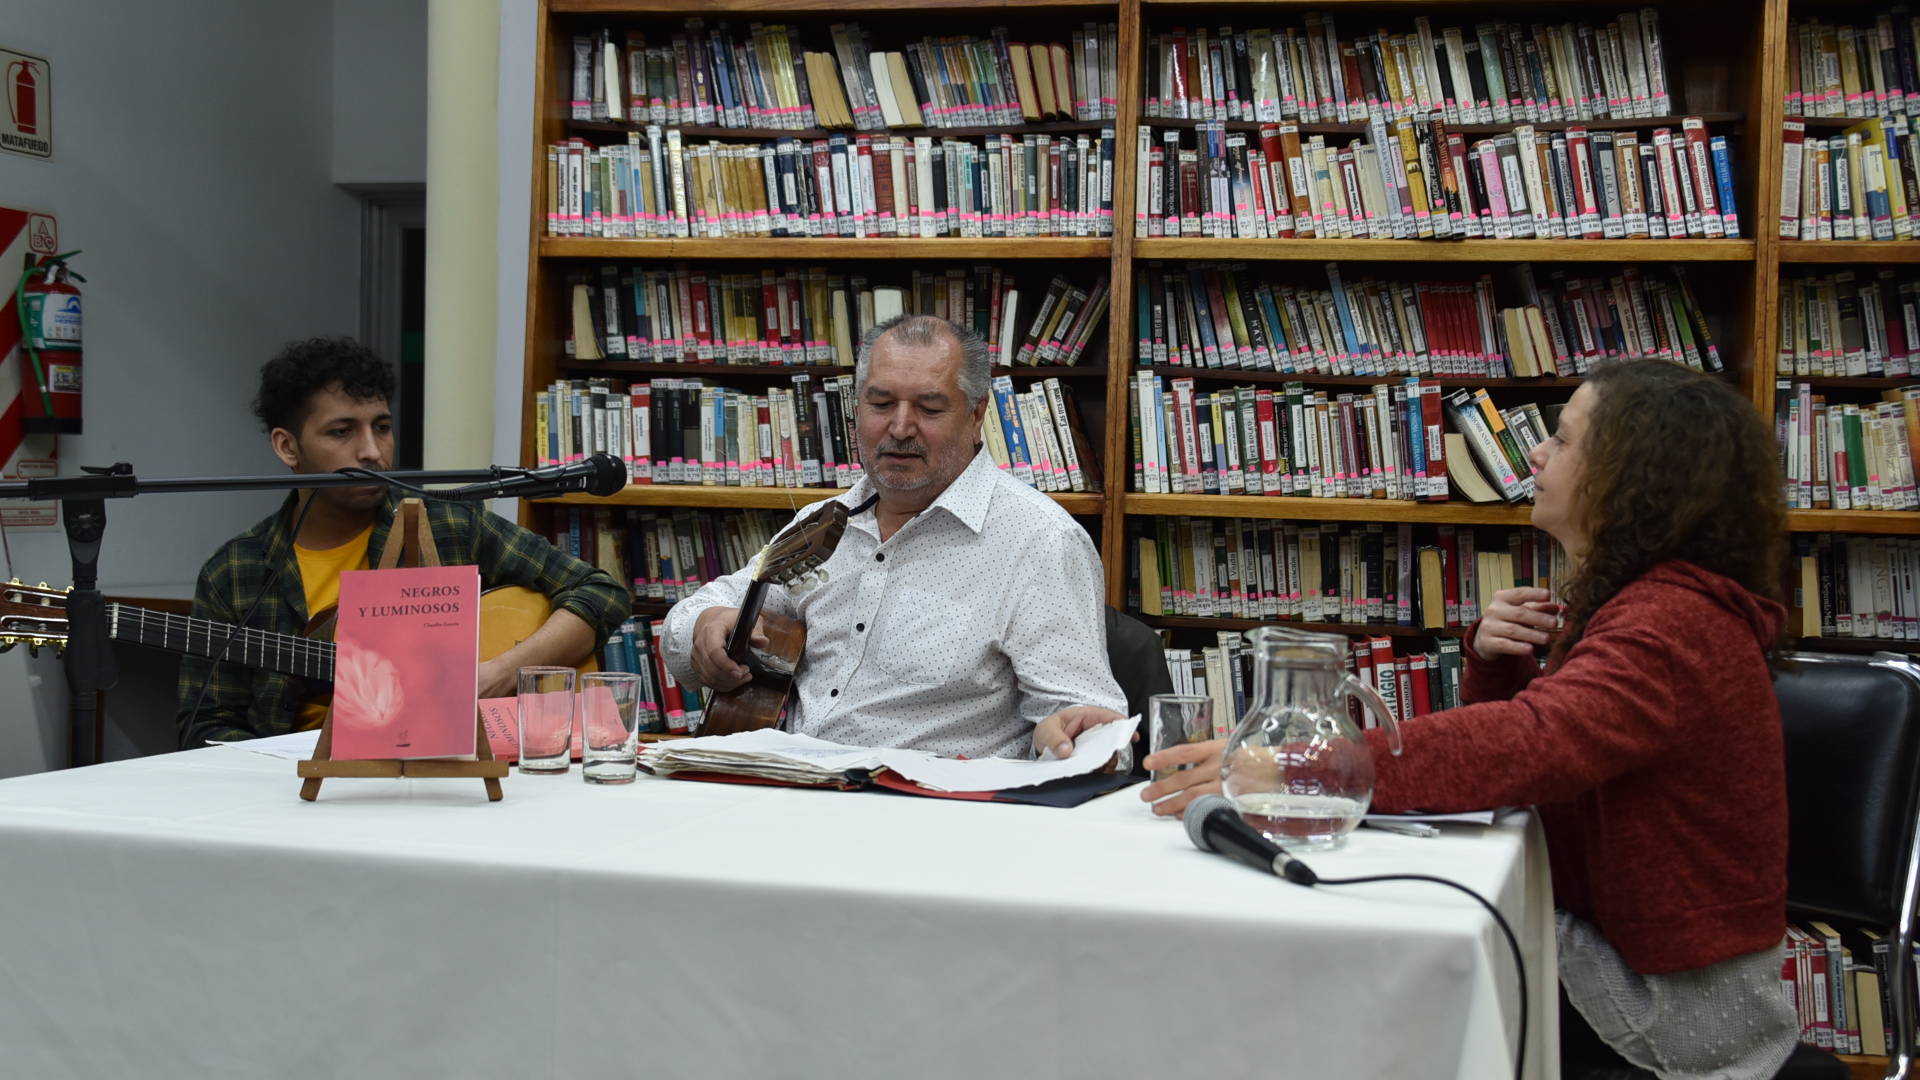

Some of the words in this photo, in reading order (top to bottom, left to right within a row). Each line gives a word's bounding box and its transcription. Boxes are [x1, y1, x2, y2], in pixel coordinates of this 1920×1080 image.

[1, 133, 49, 152] MATAFUEGO
[1604, 167, 1615, 204] FURIA
[1840, 183, 1847, 193] de
[1706, 197, 1712, 205] El
[400, 585, 460, 598] NEGROS
[358, 607, 367, 617] Y
[372, 603, 460, 617] LUMINOSOS
